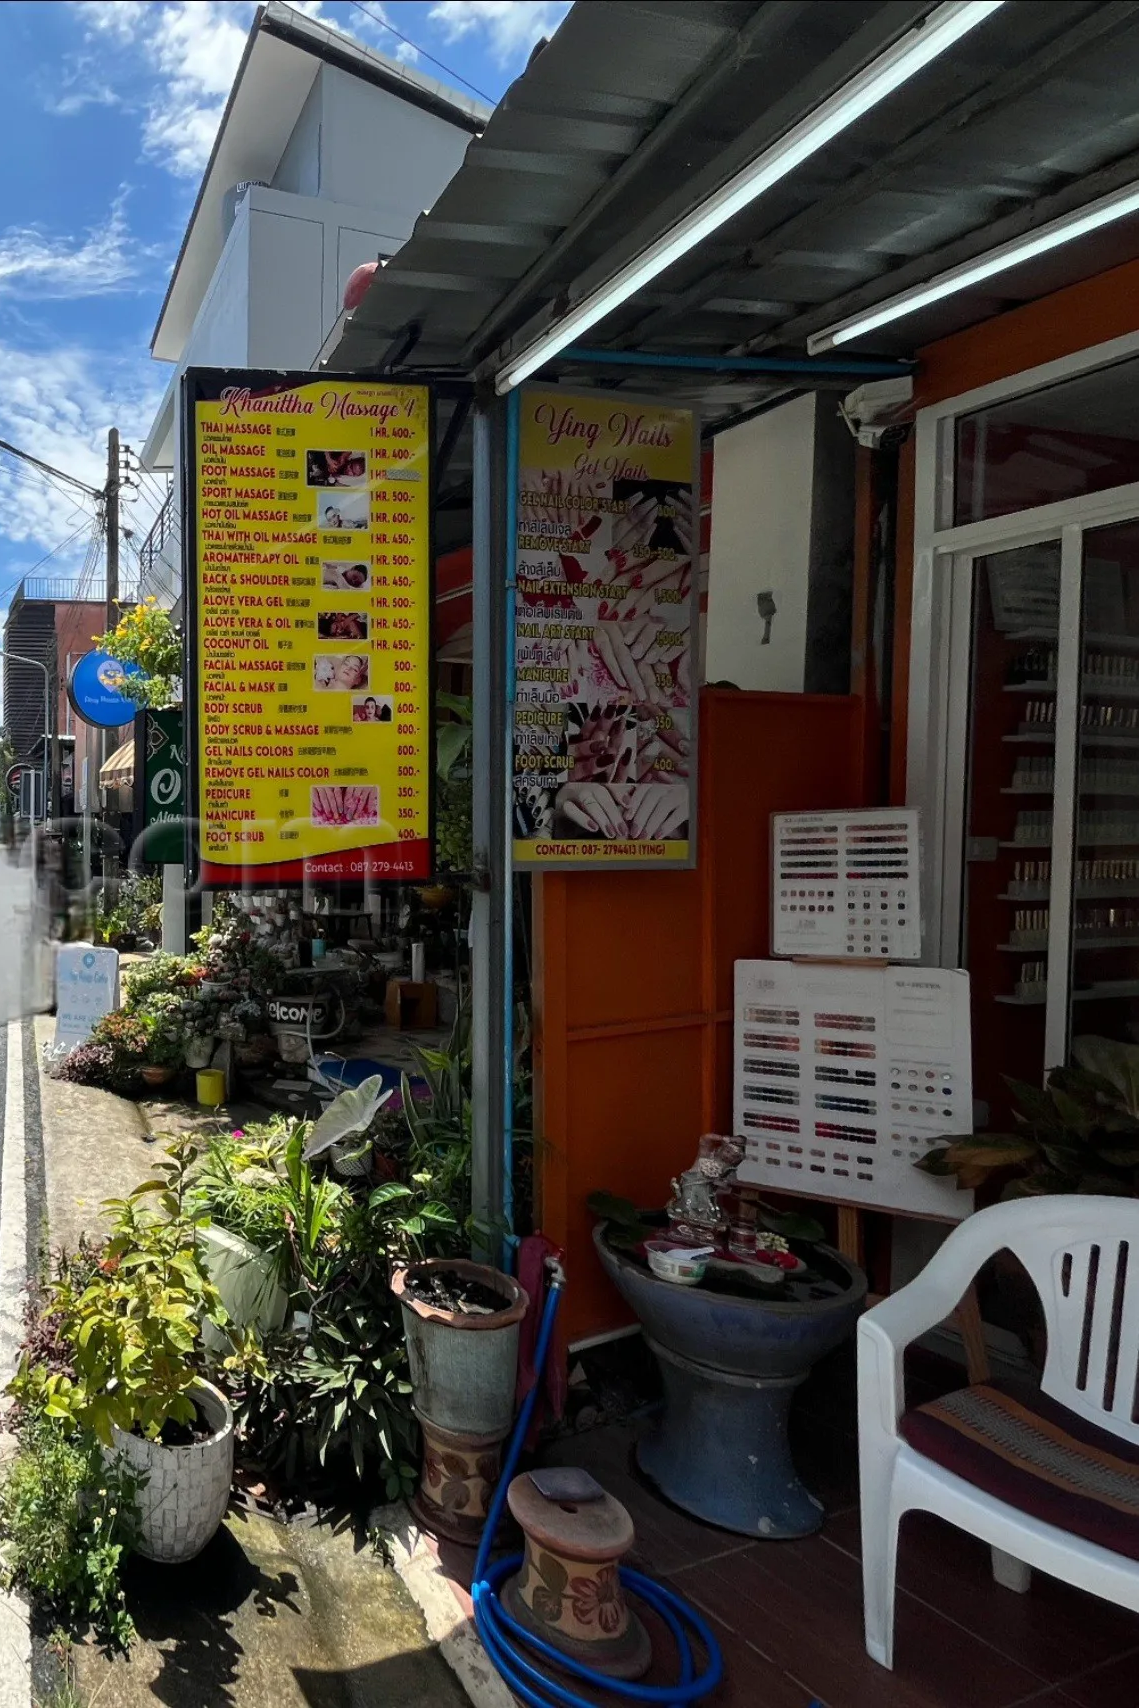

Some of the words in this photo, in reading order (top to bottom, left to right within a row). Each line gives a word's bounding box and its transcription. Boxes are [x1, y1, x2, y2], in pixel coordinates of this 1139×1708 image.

[219, 386, 315, 420] Khanittha
[320, 392, 399, 424] Massage
[201, 422, 223, 433] THAI
[226, 423, 272, 435] MASSAGE
[375, 427, 390, 438] HR.
[534, 404, 600, 449] Ying
[607, 413, 673, 449] Nails
[201, 444, 217, 456] OIL
[220, 445, 266, 456] MASSAGE
[375, 449, 390, 460] HR.
[201, 466, 227, 477] FOOT
[230, 466, 276, 478] MASSAGE
[604, 459, 648, 481] Nails
[202, 488, 232, 499] SPORT
[235, 489, 275, 500] MASAGE
[375, 492, 390, 503] HR.
[520, 491, 540, 507] GEL
[540, 493, 564, 509] NAIL
[566, 496, 598, 511] COLOR
[601, 500, 631, 515] START
[202, 509, 222, 521] HOT
[224, 510, 241, 521] OIL
[243, 511, 288, 521] MASSAGE
[375, 513, 390, 524] HR.
[202, 531, 224, 542] THAI
[227, 532, 251, 543] WITH
[253, 532, 270, 543] OIL
[272, 532, 318, 544] MASSAGE
[375, 534, 390, 546] HR.
[518, 536, 559, 551] REMOVE
[561, 540, 592, 554] START
[202, 553, 280, 564] AROMATHERAPY
[283, 553, 299, 564] OIL
[375, 556, 390, 566] HR.
[203, 574, 227, 585] BACK
[231, 574, 237, 585] &
[240, 574, 290, 586] SHOULDER
[375, 577, 390, 587] HR.
[517, 580, 541, 594] NAIL
[543, 582, 597, 598] EXTENSION
[598, 585, 629, 599] START
[203, 596, 235, 607] ALOVE
[238, 596, 263, 607] VERA
[266, 596, 284, 607] GEL
[375, 598, 390, 609] HR.
[203, 617, 235, 629] ALOVE
[238, 617, 263, 629] VERA
[267, 618, 273, 628] &
[276, 618, 291, 629] OIL
[375, 619, 390, 630] HR.
[517, 624, 540, 638] NAIL
[542, 624, 562, 639] ART
[564, 626, 595, 640] START
[203, 638, 251, 650] COCONUT
[254, 639, 269, 650] OIL
[375, 640, 390, 651] HR.
[203, 661, 237, 672] FACIAL
[239, 661, 284, 672] MASSAGE
[517, 667, 569, 683] MANICURE
[204, 682, 237, 692] FACIAL
[240, 682, 246, 692] &
[249, 682, 276, 693] MASK
[204, 703, 230, 714] BODY
[233, 704, 263, 714] SCRUB
[515, 711, 564, 726] PEDICURE
[205, 725, 230, 736] BODY
[233, 725, 263, 736] SCRUB
[266, 725, 272, 735] &
[274, 725, 319, 736] MASSAGE
[205, 746, 223, 757] GEL
[225, 746, 253, 757] NAILS
[255, 746, 294, 757] COLORS
[515, 755, 541, 770] FOOT
[544, 755, 575, 770] SCRUB
[205, 767, 245, 778] REMOVE
[247, 767, 265, 778] GEL
[268, 767, 295, 778] NAILS
[297, 767, 329, 778] COLOR
[205, 788, 251, 799] PEDICURE
[206, 810, 256, 821] MANICURE
[206, 831, 232, 842] FOOT
[234, 832, 265, 842] SCRUB
[535, 844, 579, 856] CONTACT:
[304, 862, 343, 872] Contact
[267, 1001, 326, 1023] elcome
